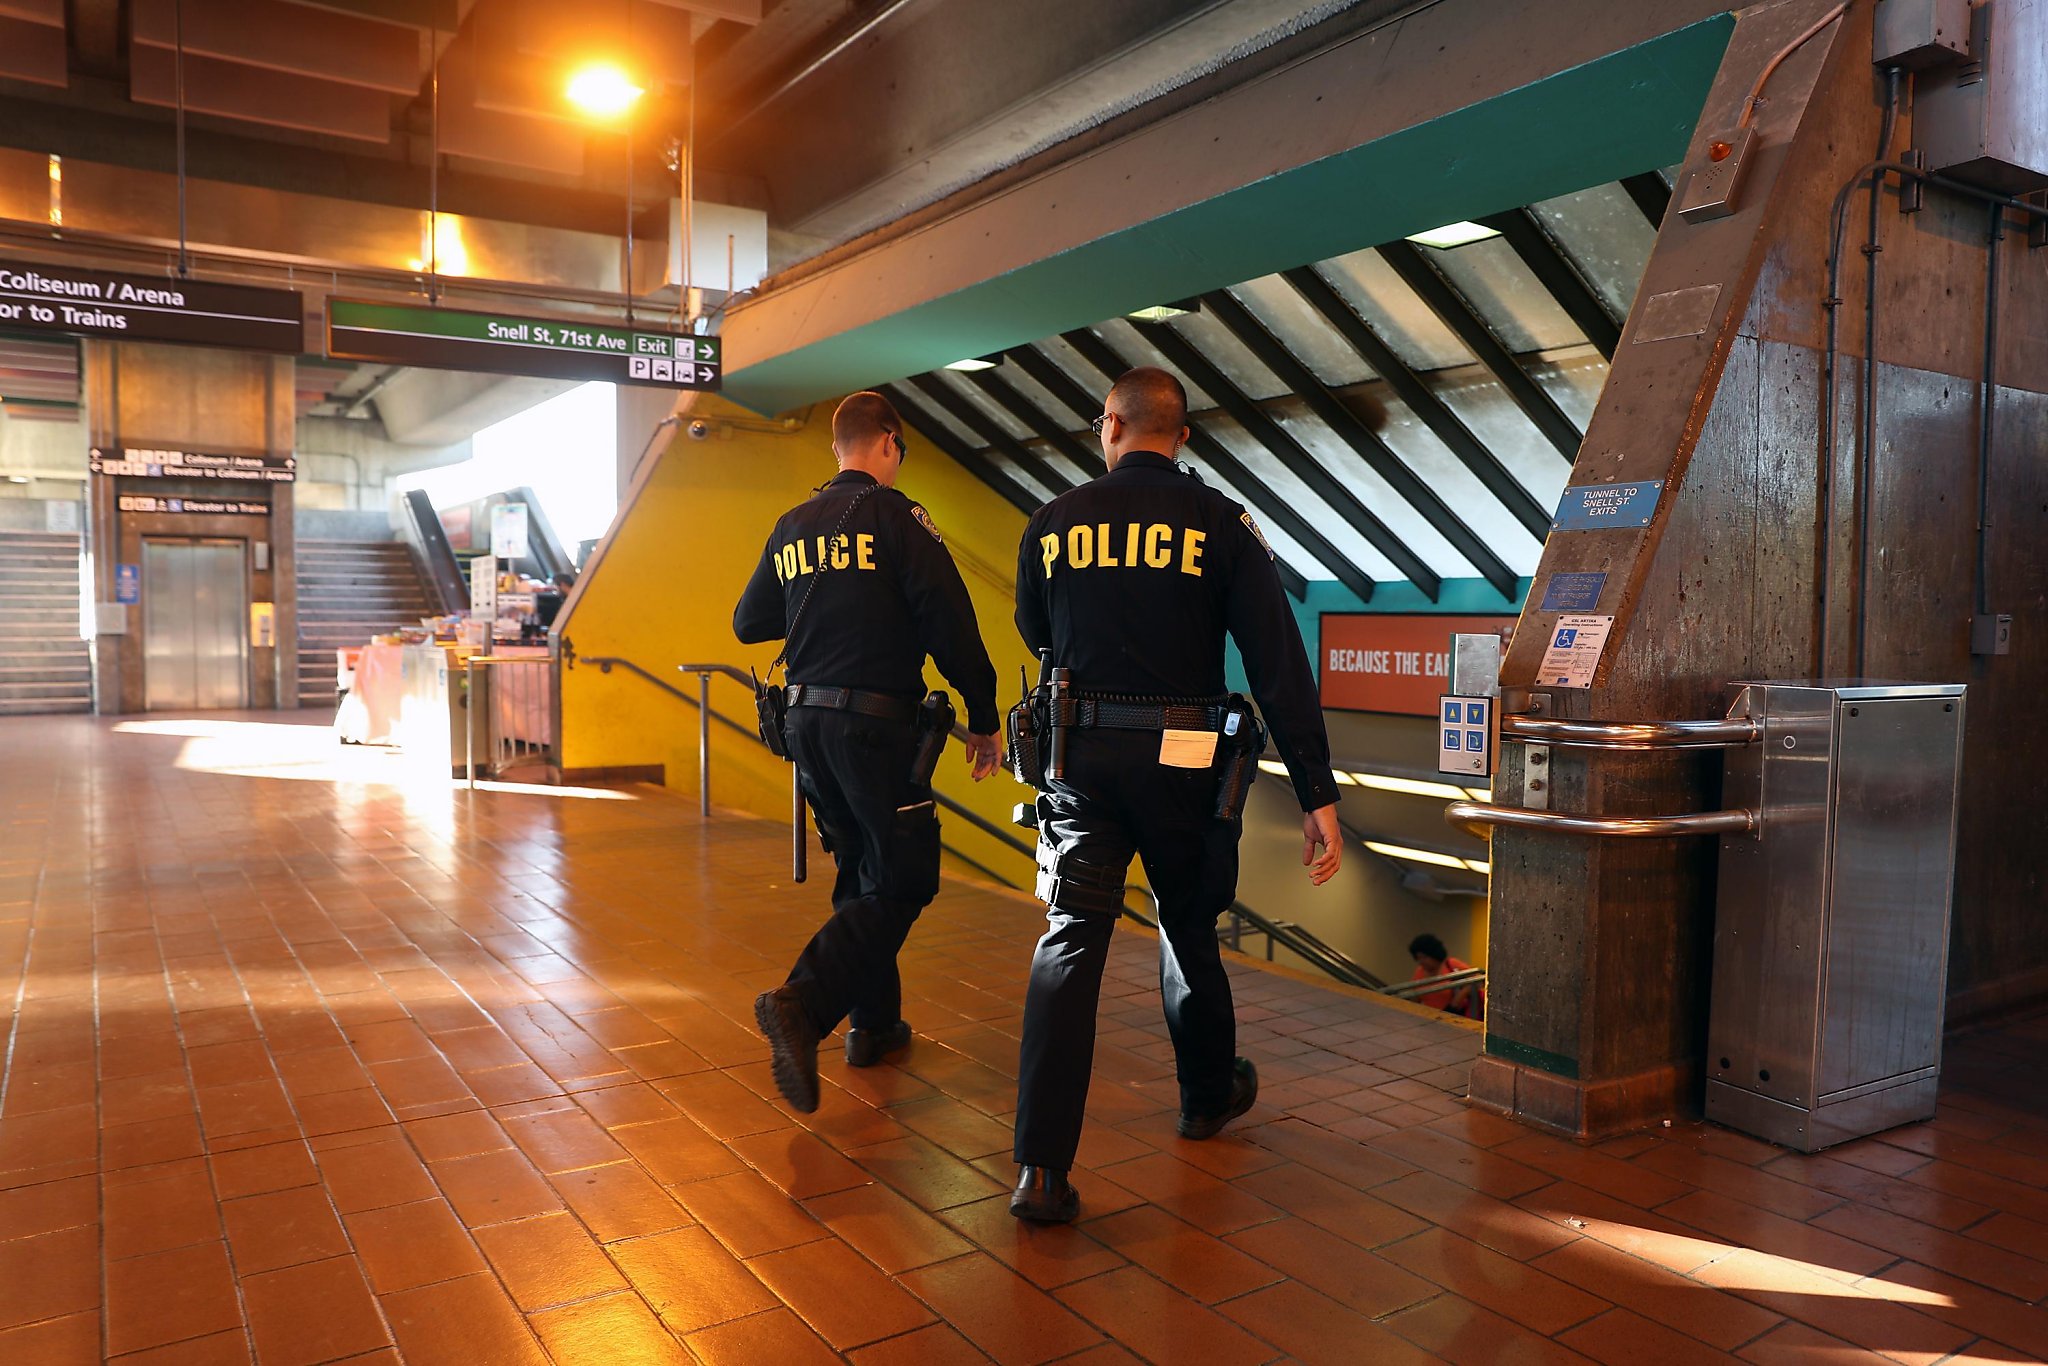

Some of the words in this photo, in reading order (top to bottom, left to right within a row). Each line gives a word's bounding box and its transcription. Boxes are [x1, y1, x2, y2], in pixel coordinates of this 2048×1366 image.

[0, 269, 100, 298] Coliseum
[106, 281, 116, 299] /
[119, 283, 185, 307] Arena
[29, 304, 55, 322] to
[60, 305, 127, 329] Trains
[487, 322, 528, 340] Snell
[533, 326, 554, 345] St,
[559, 329, 592, 347] 71st
[596, 334, 627, 350] Ave
[637, 337, 667, 355] Exit
[184, 453, 228, 466] Coliseum
[235, 456, 264, 468] Arena
[163, 465, 203, 477] Elevator
[204, 468, 216, 478] to
[217, 468, 260, 480] Coliseum
[266, 470, 294, 481] Arena
[1583, 489, 1621, 499] TUNNEL
[1624, 487, 1638, 496] TO
[183, 501, 225, 512] Elevator
[225, 503, 238, 513] to
[239, 502, 268, 514] Trains
[1582, 499, 1614, 508] SNELL
[1616, 497, 1630, 506] ST.
[1589, 506, 1618, 516] EXITS
[773, 533, 876, 587] POLICE
[1039, 523, 1207, 580] POLICE
[1329, 649, 1391, 674] BECAUSE
[1394, 651, 1421, 676] THE
